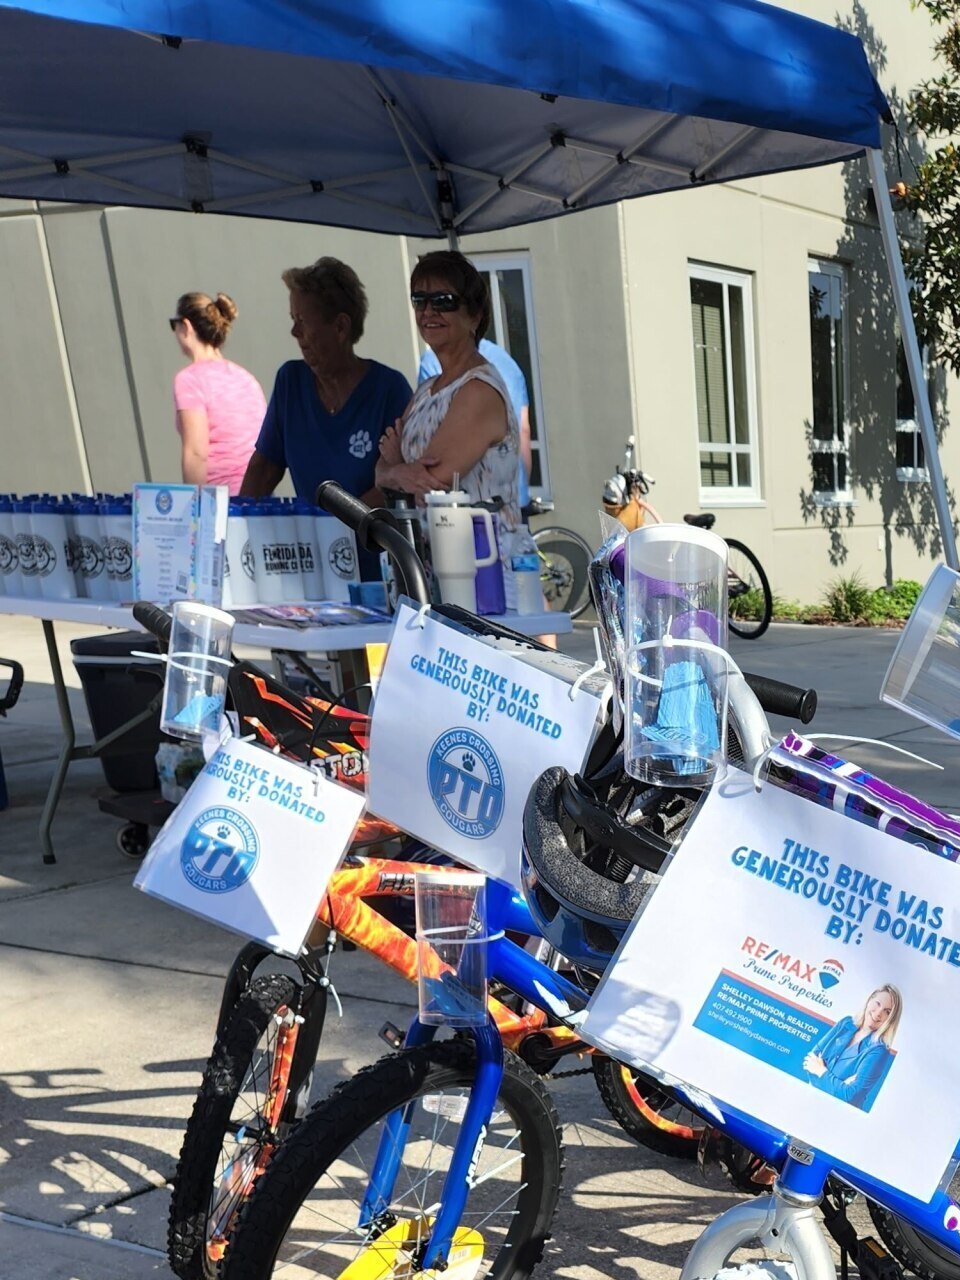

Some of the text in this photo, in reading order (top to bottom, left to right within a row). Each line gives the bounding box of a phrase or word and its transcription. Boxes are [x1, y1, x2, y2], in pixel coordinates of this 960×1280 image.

[410, 654, 563, 740] GENEROUSLY DONATED
[438, 647, 540, 709] THIS BIKE WAS
[466, 701, 490, 722] BY:
[233, 758, 270, 783] BIKE
[273, 776, 304, 798] WAS
[435, 732, 500, 786] KEENES CROSSING
[227, 786, 250, 804] BY:
[258, 785, 326, 824] DONATED
[433, 760, 504, 829] PTO
[440, 803, 485, 836] COUGARS
[226, 809, 257, 853] CROSSING
[184, 863, 227, 890] COUGARS
[730, 846, 871, 926] GENEROUSLY
[781, 838, 944, 930] THIS BIKE WAS
[824, 915, 863, 945] BY:
[741, 935, 817, 983] RE/MAX
[742, 957, 834, 1009] Prime Properties
[717, 991, 813, 1043] RE/MAX PRIME PROPERTIES
[721, 983, 819, 1036] SHELLEY DAWSON, REALTOR
